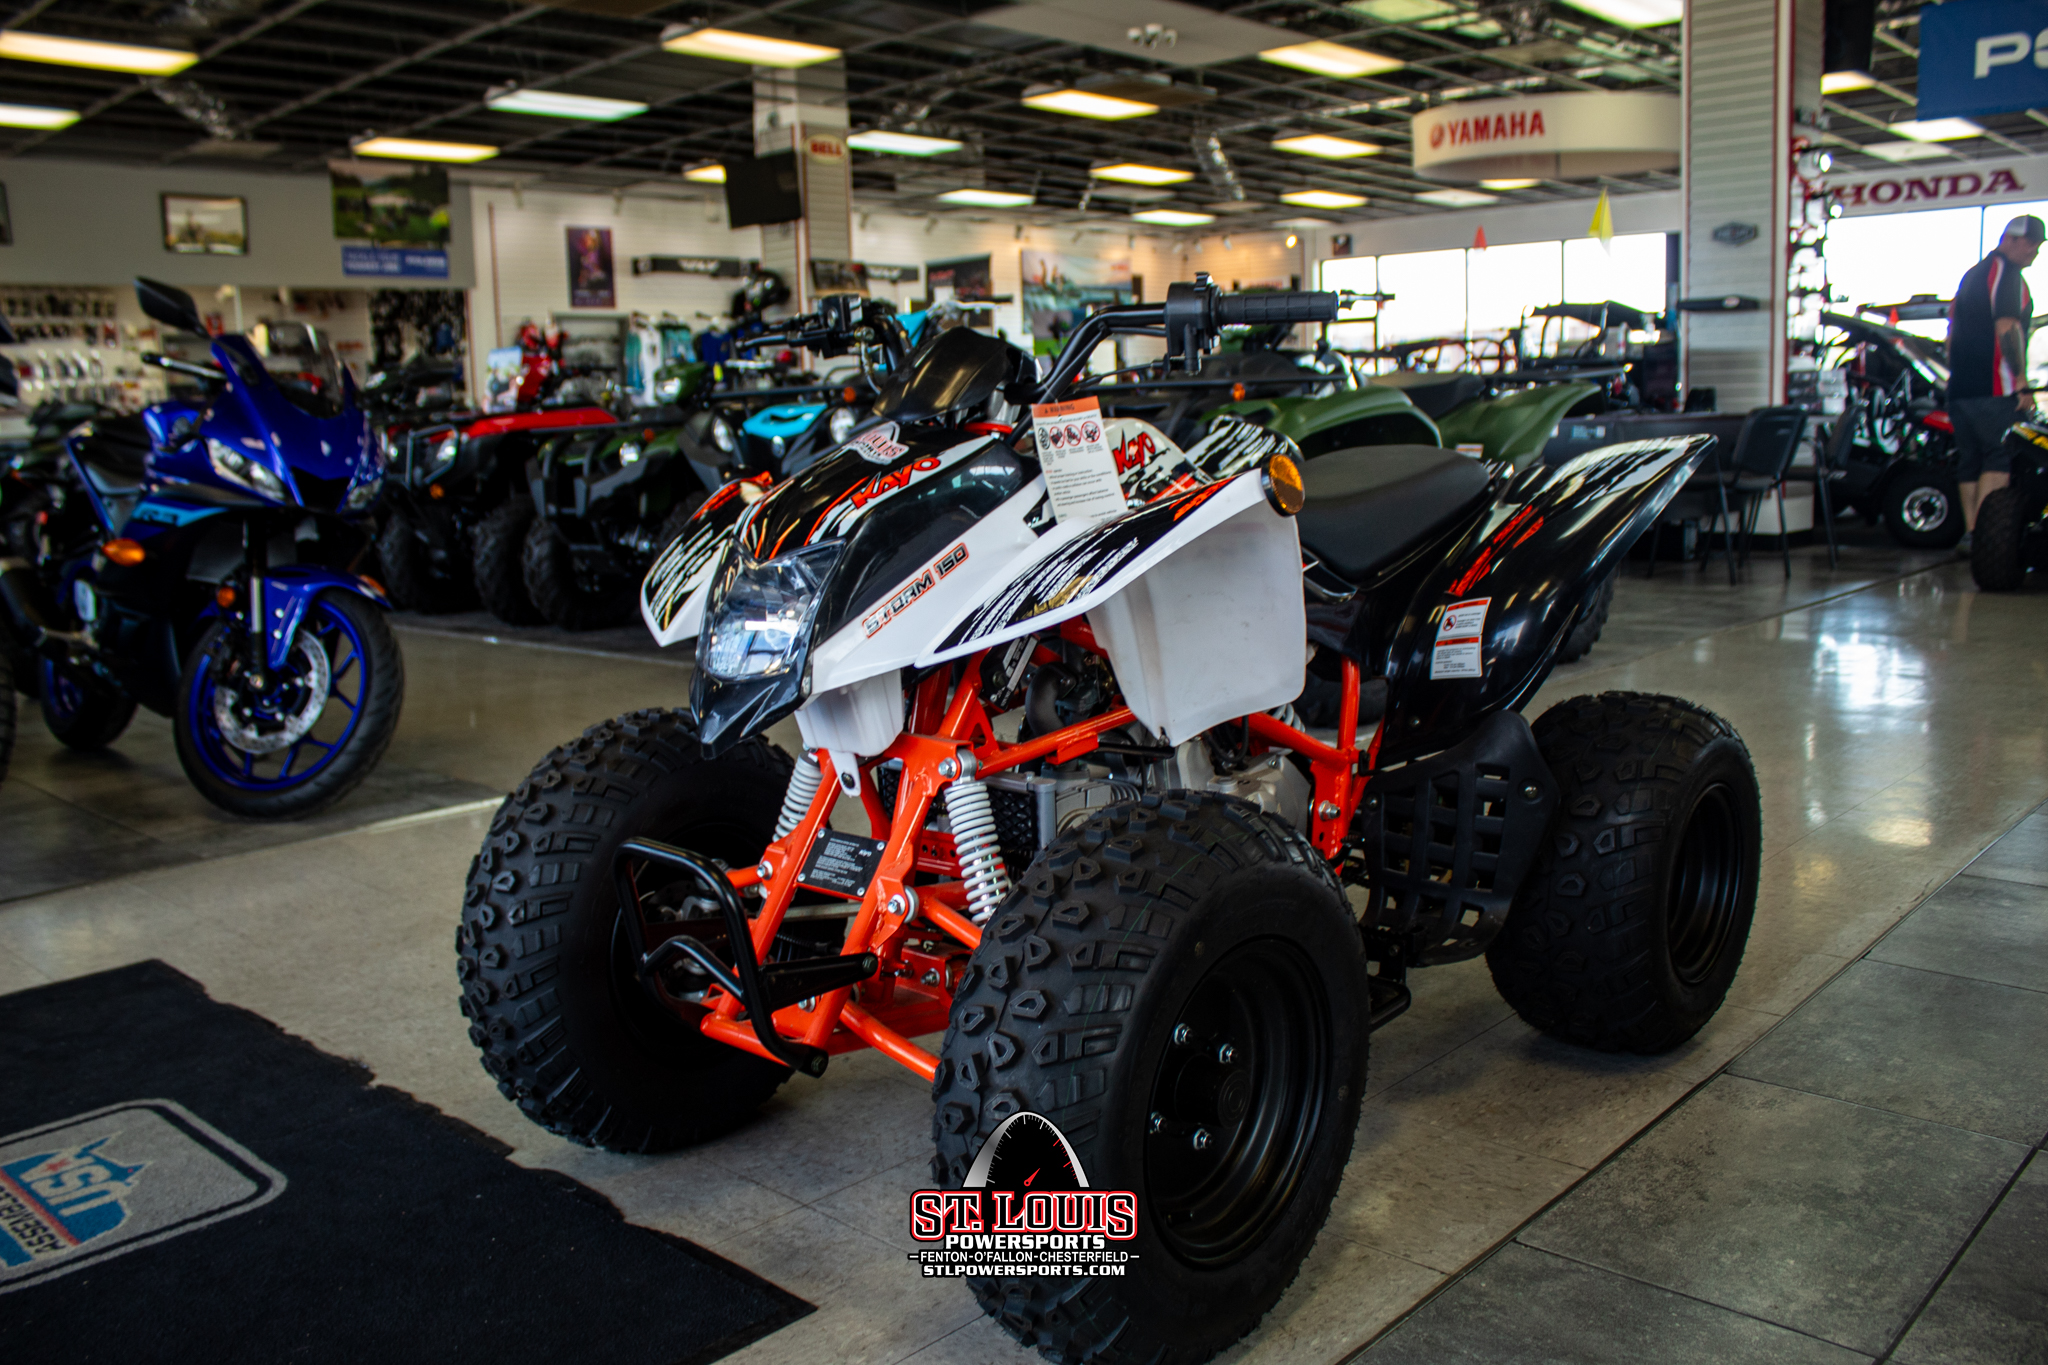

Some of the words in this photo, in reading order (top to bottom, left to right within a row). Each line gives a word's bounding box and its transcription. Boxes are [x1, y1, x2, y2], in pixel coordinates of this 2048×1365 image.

[811, 140, 843, 157] BELL
[1447, 109, 1546, 147] YAMAHA
[1831, 167, 2026, 207] HONDA
[1112, 428, 1156, 475] KAYO
[851, 457, 942, 509] KAYO
[863, 570, 934, 637] STORM
[935, 544, 968, 578] 150
[19, 1148, 132, 1217] USA
